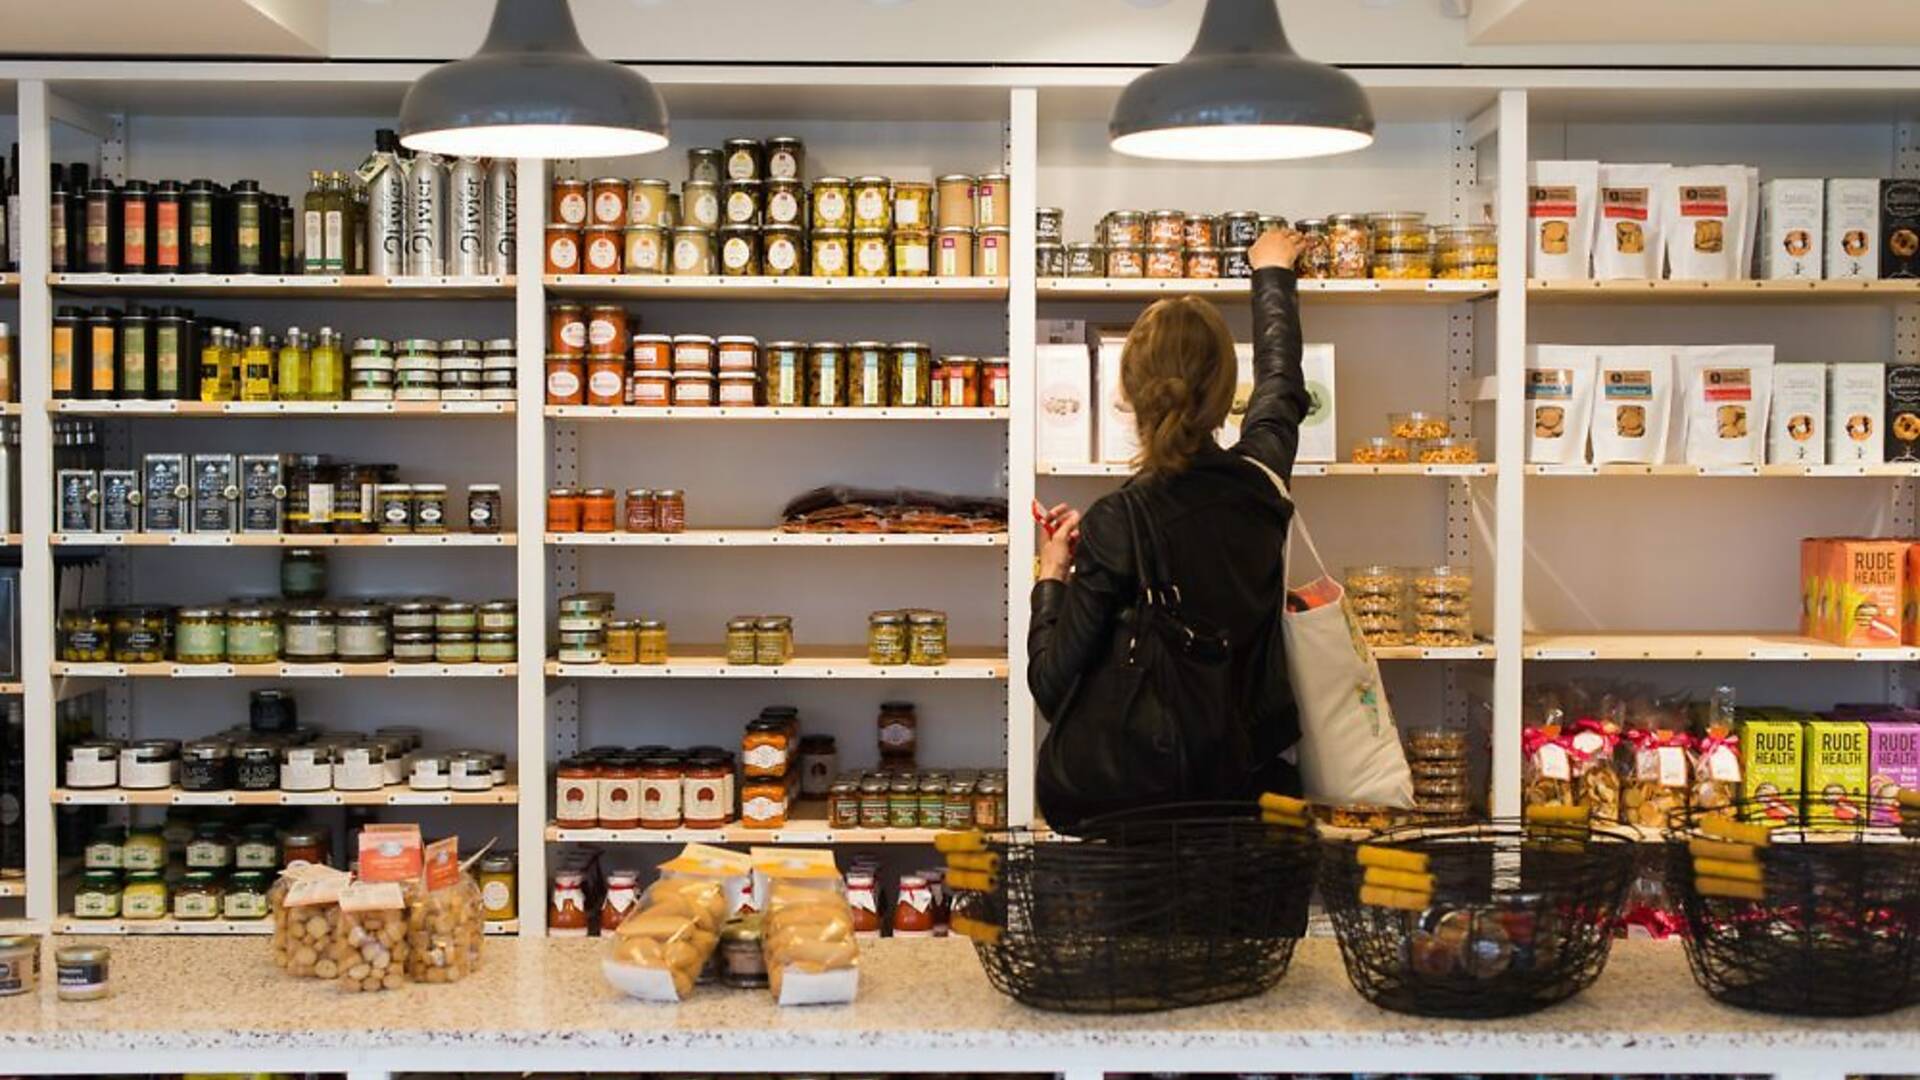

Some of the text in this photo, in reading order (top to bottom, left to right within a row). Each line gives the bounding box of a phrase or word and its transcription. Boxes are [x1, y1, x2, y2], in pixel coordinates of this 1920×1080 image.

[412, 177, 432, 253] Olivier
[460, 178, 481, 253] Olivier
[1855, 552, 1896, 570] RUDE
[1854, 571, 1896, 585] HEALTH
[1756, 733, 1796, 750] RUDE
[1822, 733, 1861, 751] RUDE
[1879, 733, 1918, 751] RUDE
[1755, 752, 1796, 765] HEALTH
[1821, 752, 1861, 765] HEALTH
[1878, 752, 1918, 765] HEALTH
